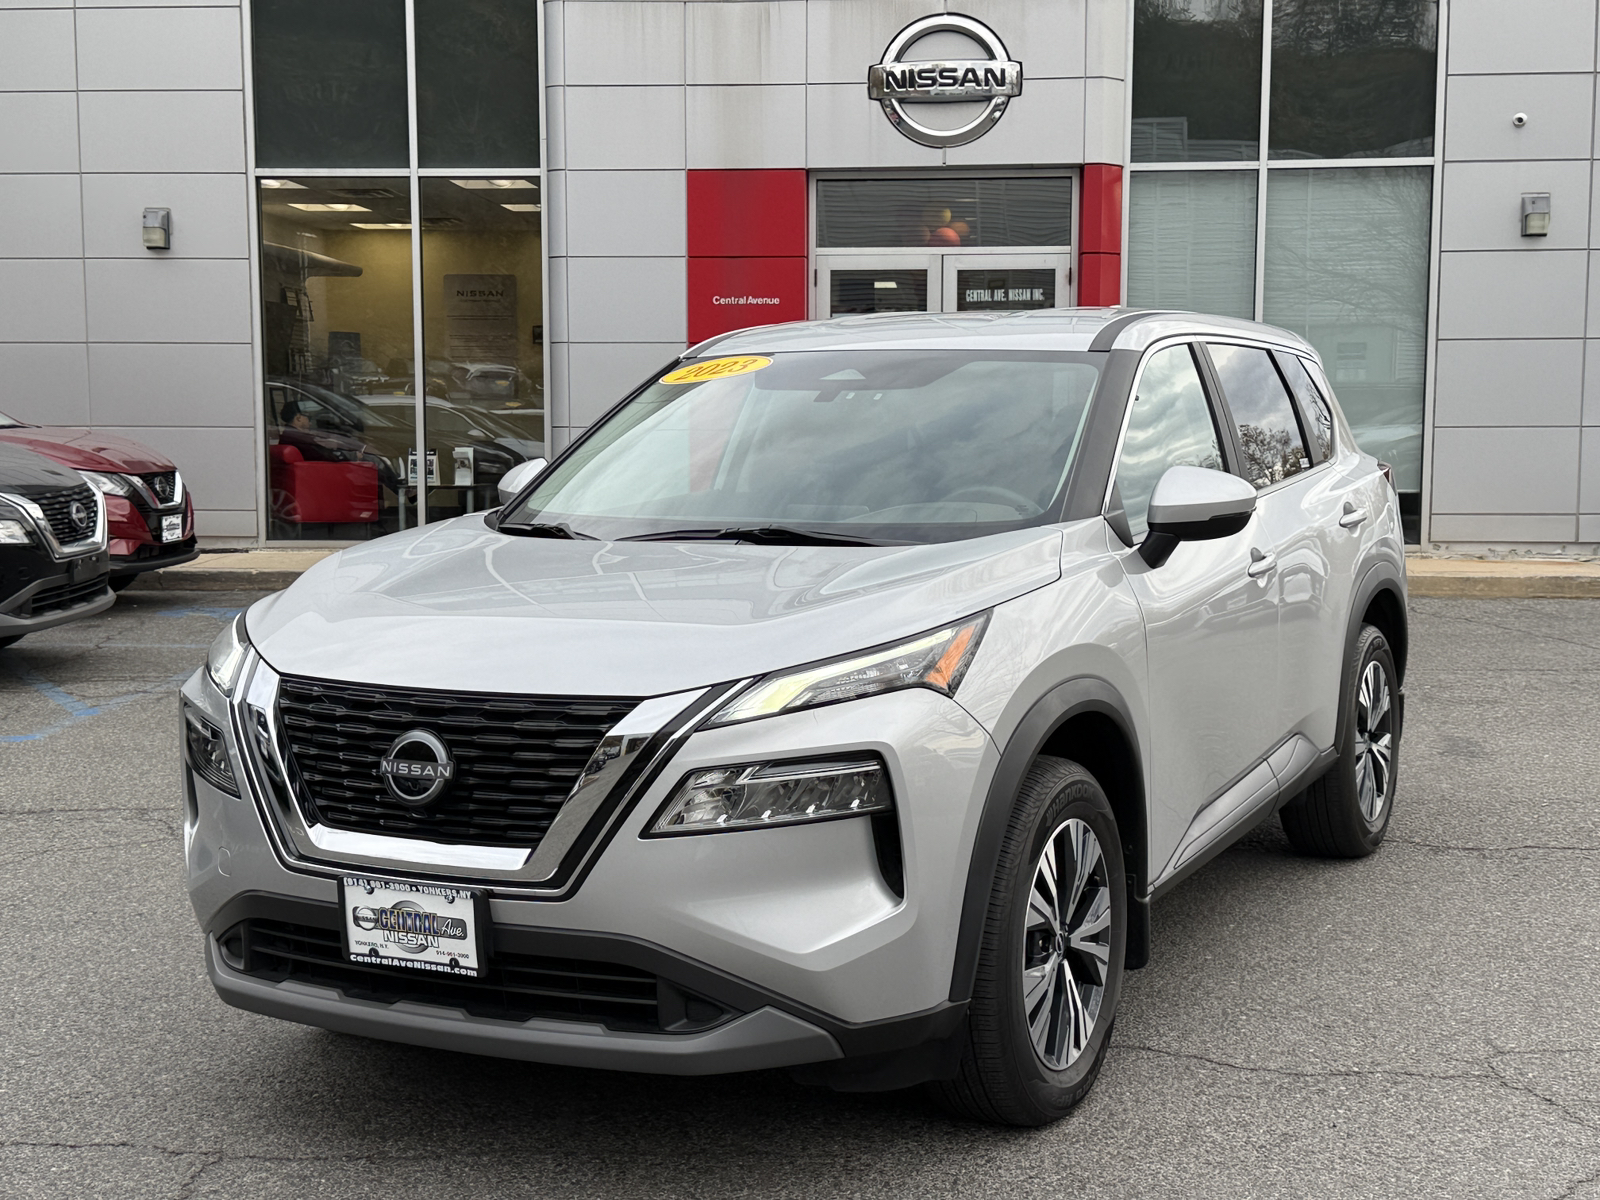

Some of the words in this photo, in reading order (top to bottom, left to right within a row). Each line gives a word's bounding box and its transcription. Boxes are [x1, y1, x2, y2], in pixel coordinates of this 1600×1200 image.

[884, 67, 1006, 91] NISSAN
[456, 290, 504, 298] NISSAN
[712, 296, 746, 305] Central
[747, 296, 780, 305] Avenue
[965, 289, 992, 302] CENTRAL
[993, 289, 1007, 302] AVE.
[1008, 288, 1031, 301] NISSAN
[674, 359, 758, 382] 2023
[382, 760, 450, 777] NISSAN
[378, 906, 440, 936] CENTRAL
[441, 918, 465, 937] Ave.
[383, 930, 440, 948] NISSAN
